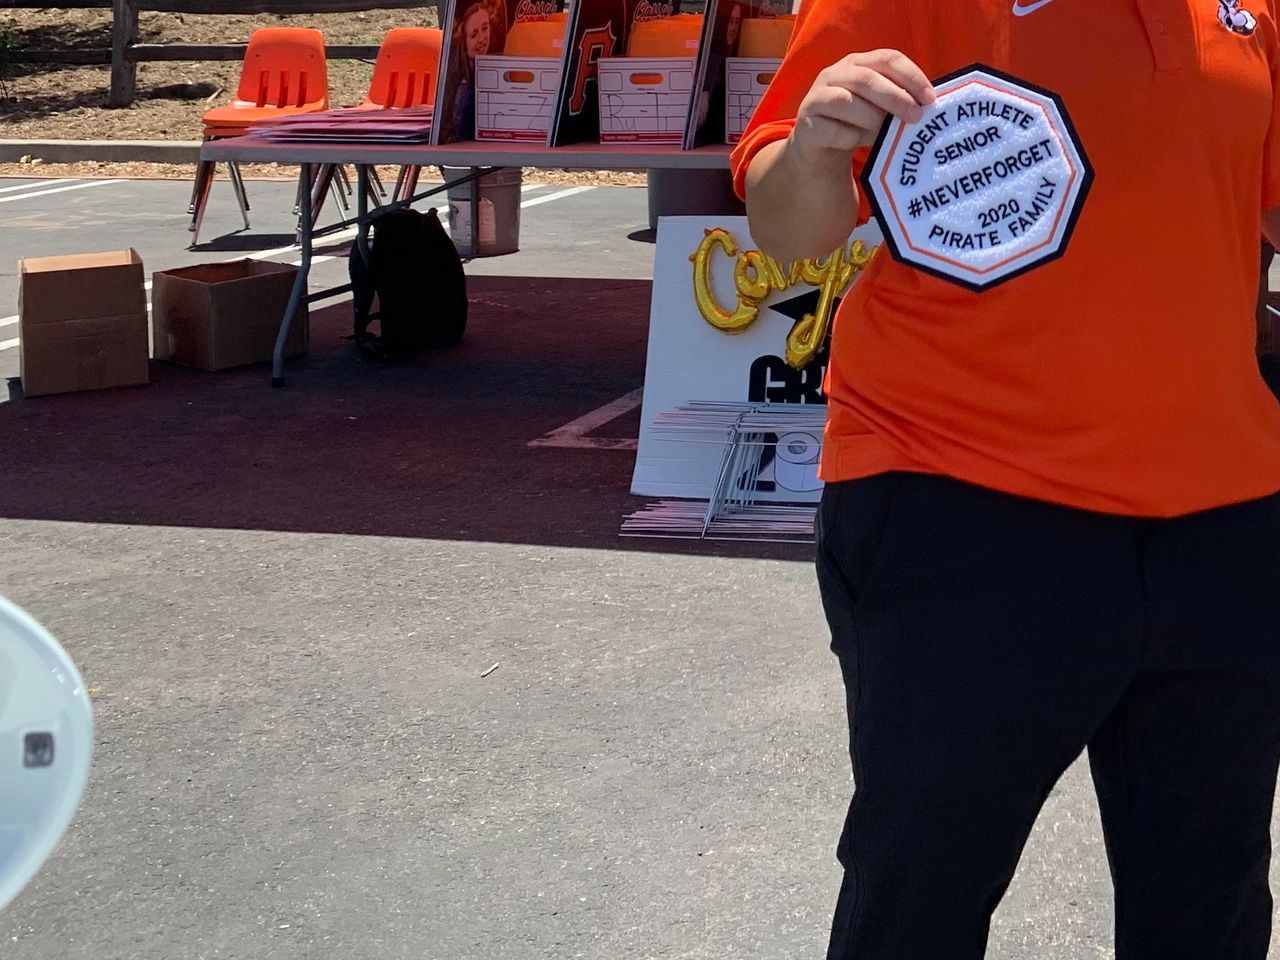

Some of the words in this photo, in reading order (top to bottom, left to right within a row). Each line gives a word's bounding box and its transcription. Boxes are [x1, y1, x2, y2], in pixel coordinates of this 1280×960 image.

[900, 113, 949, 187] STUDENT
[956, 101, 1034, 130] ATHLETE
[907, 139, 1054, 218] #NEVERFORGET
[934, 126, 1001, 165] SENIOR
[928, 224, 1002, 250] PIRATE
[1008, 176, 1057, 238] FAMILY
[977, 199, 1021, 229] 2020
